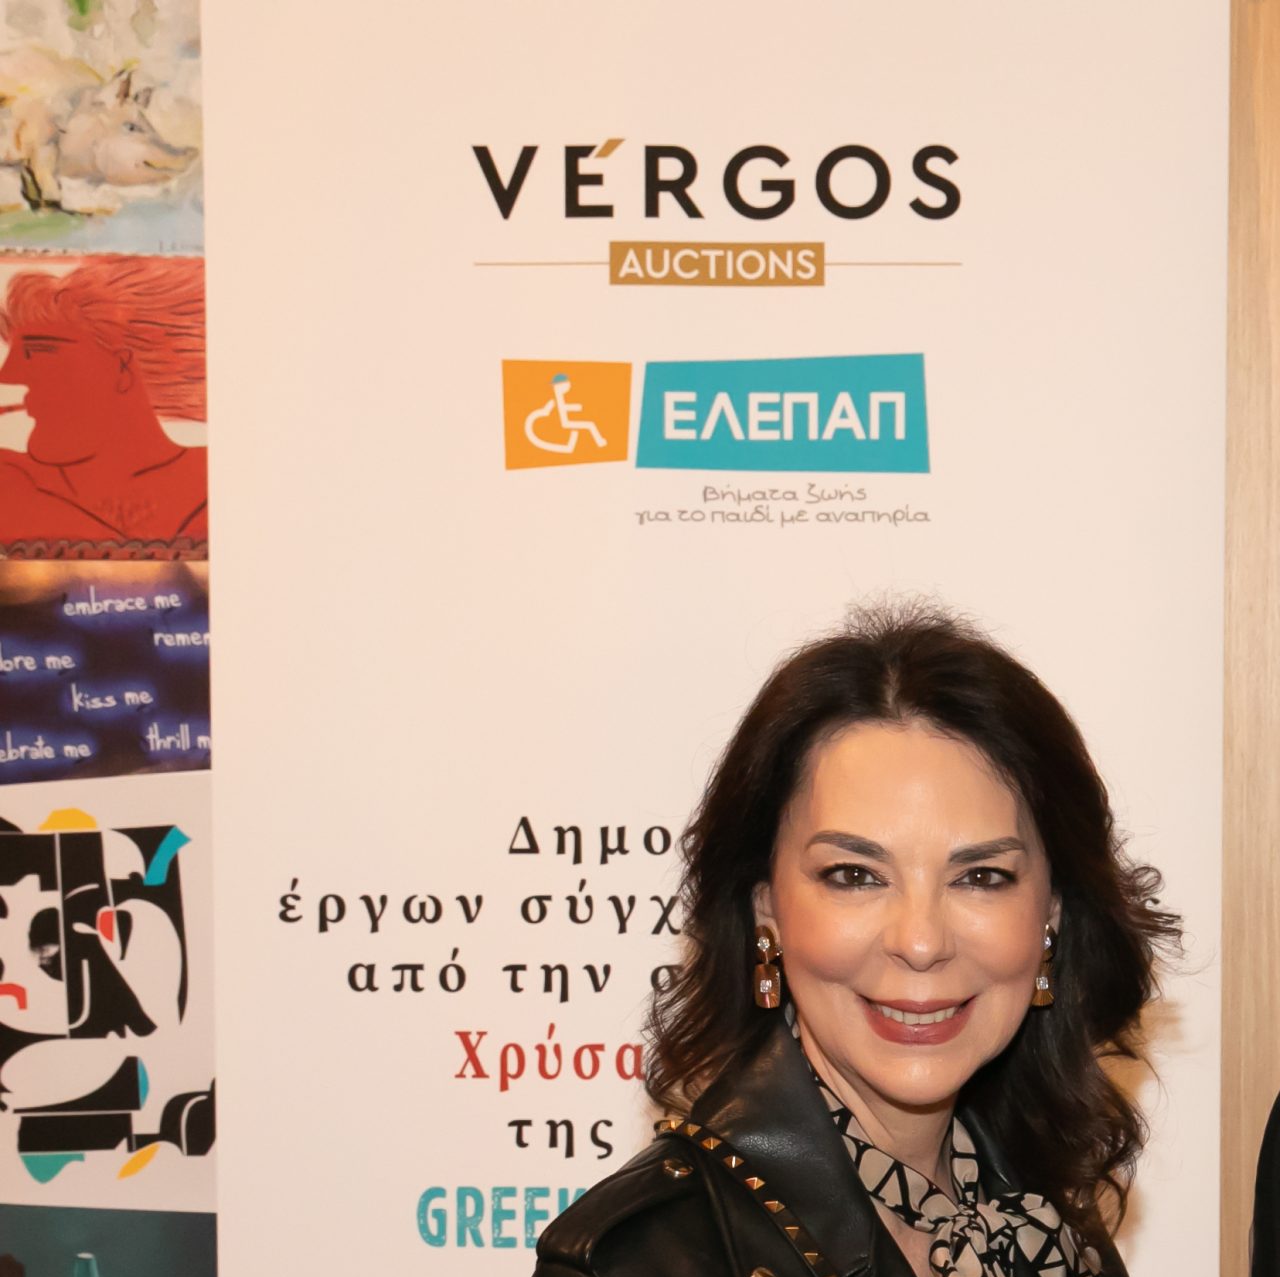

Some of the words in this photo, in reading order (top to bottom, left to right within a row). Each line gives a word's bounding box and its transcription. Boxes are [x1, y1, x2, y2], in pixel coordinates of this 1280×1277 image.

[472, 139, 962, 220] VÉRGOS
[618, 248, 817, 280] AUCTIONS
[663, 391, 906, 441] ΕΛΕΠΑΠ
[634, 509, 672, 526] για
[678, 510, 706, 522] το
[780, 509, 809, 528] με
[63, 585, 147, 617] embrace
[154, 592, 182, 608] me
[45, 655, 76, 670] me
[71, 682, 117, 712] kiss
[124, 690, 154, 705] me
[0, 730, 56, 763] ebrate
[63, 744, 93, 758] me
[146, 722, 191, 751] thrill
[197, 735, 210, 749] m
[508, 816, 673, 865] Δημο
[278, 877, 484, 934] έργων
[520, 879, 682, 935] σύγχ
[347, 947, 467, 994] από
[501, 963, 612, 1004] την
[454, 1022, 645, 1092] Χρύσα
[507, 1119, 614, 1159] της
